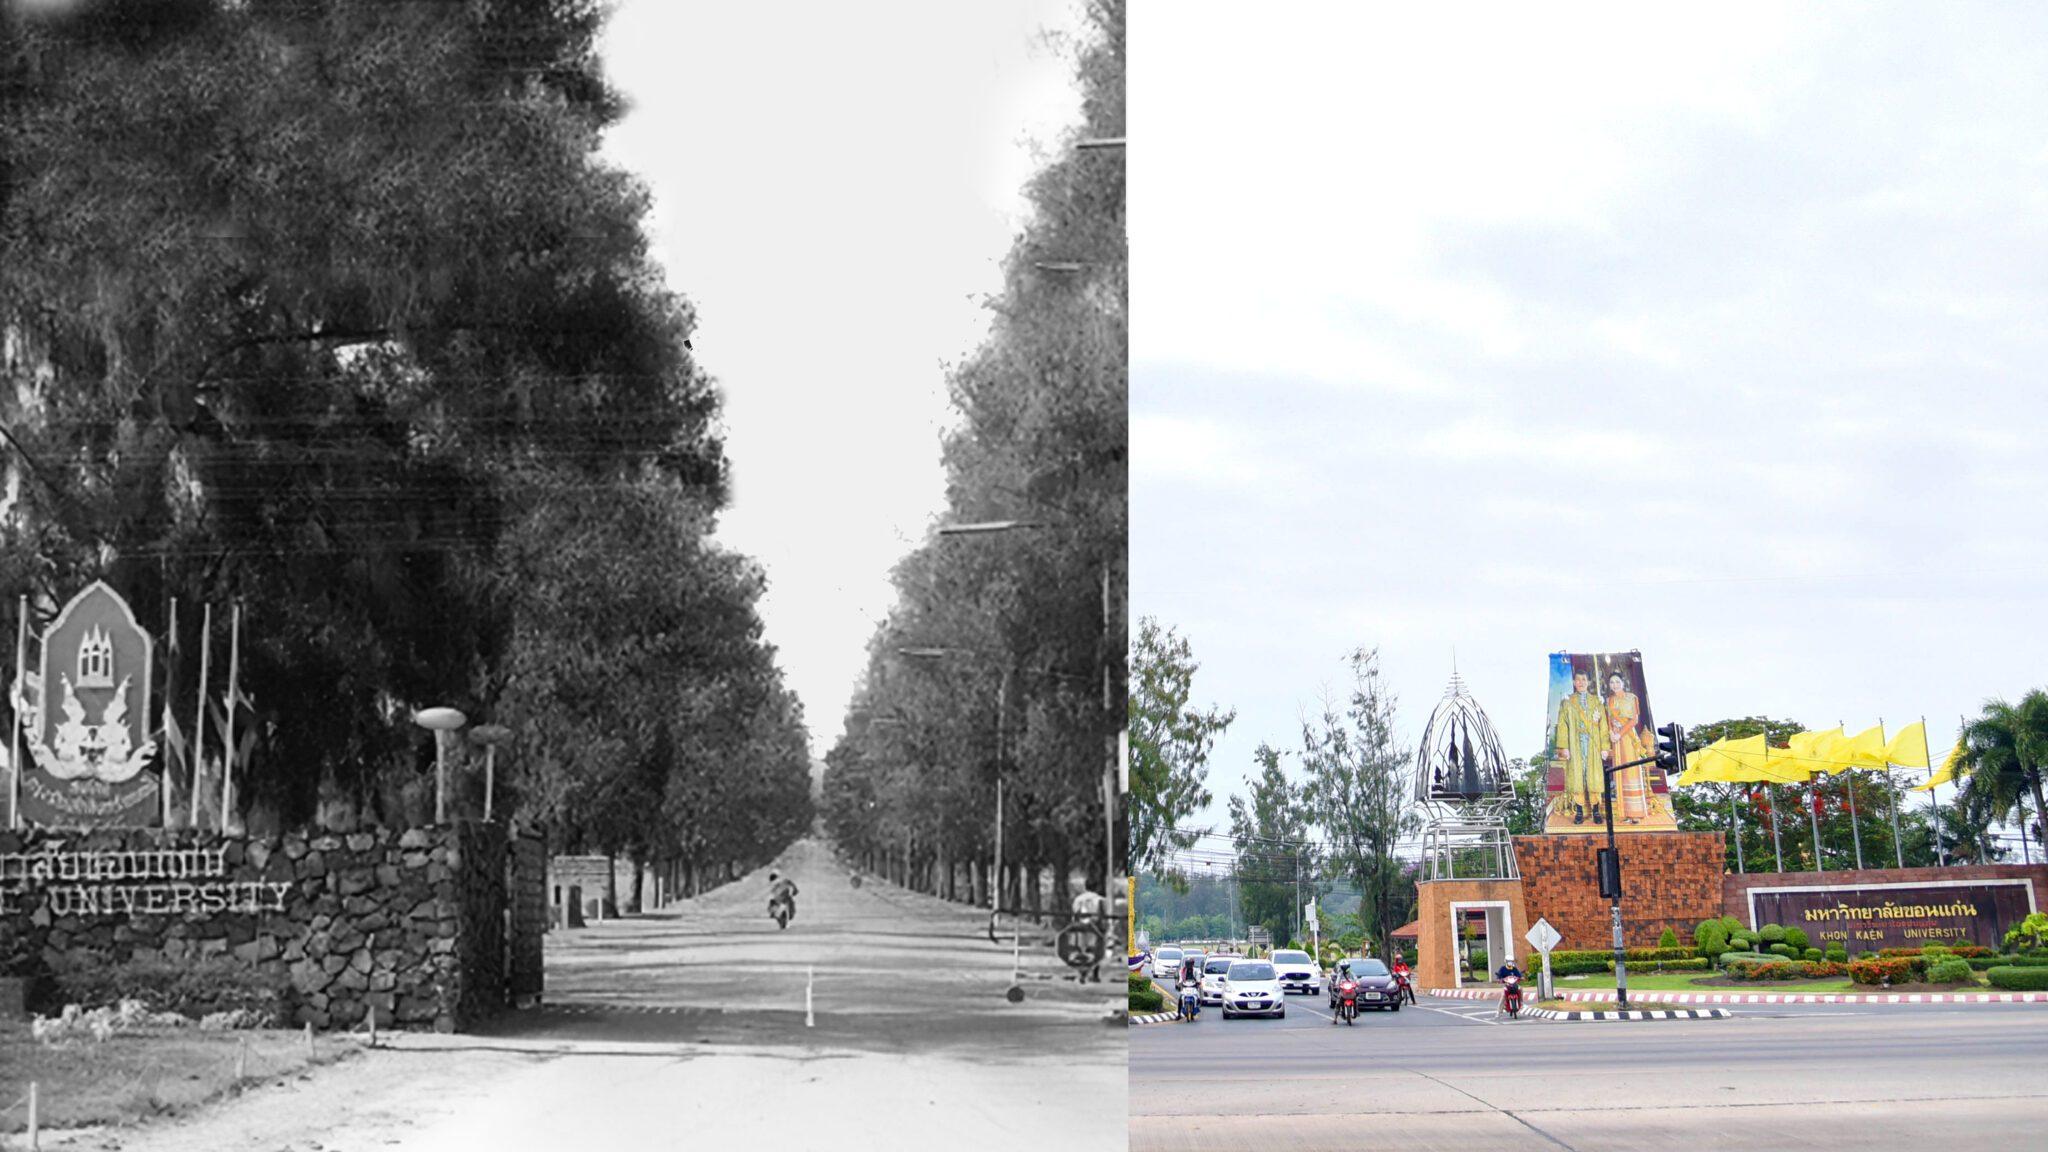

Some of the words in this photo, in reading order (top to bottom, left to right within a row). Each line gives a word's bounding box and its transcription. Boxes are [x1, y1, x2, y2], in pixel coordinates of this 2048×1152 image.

[49, 882, 292, 915] UNIVERSITY
[1805, 900, 1978, 921] มหาวิทยาลัยขอนแก่น
[1819, 931, 1848, 941] KHON
[1855, 929, 1884, 941] KAEN
[1904, 927, 1967, 939] UNIVERSITY
